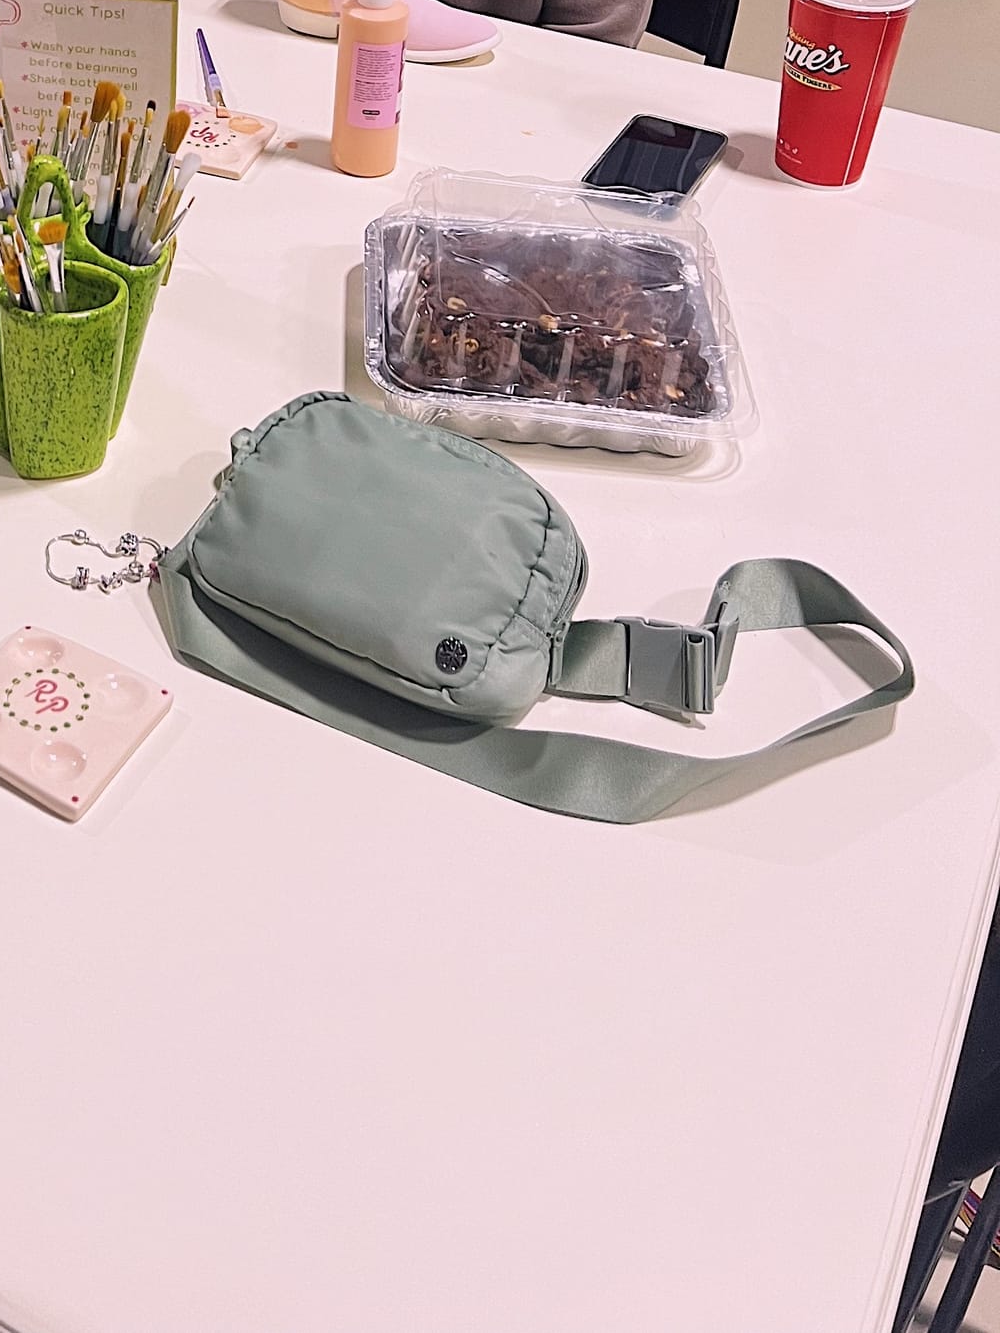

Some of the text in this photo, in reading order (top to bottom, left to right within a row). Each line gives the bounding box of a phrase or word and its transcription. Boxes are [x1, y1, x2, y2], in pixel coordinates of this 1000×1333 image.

[43, 2, 126, 19] Quick Tips!
[30, 41, 137, 58] Wash your hands
[29, 57, 138, 77] before beginning
[29, 73, 66, 86] Shake
[37, 91, 80, 104] befe
[22, 106, 53, 118] Light
[25, 679, 70, 714] RP
